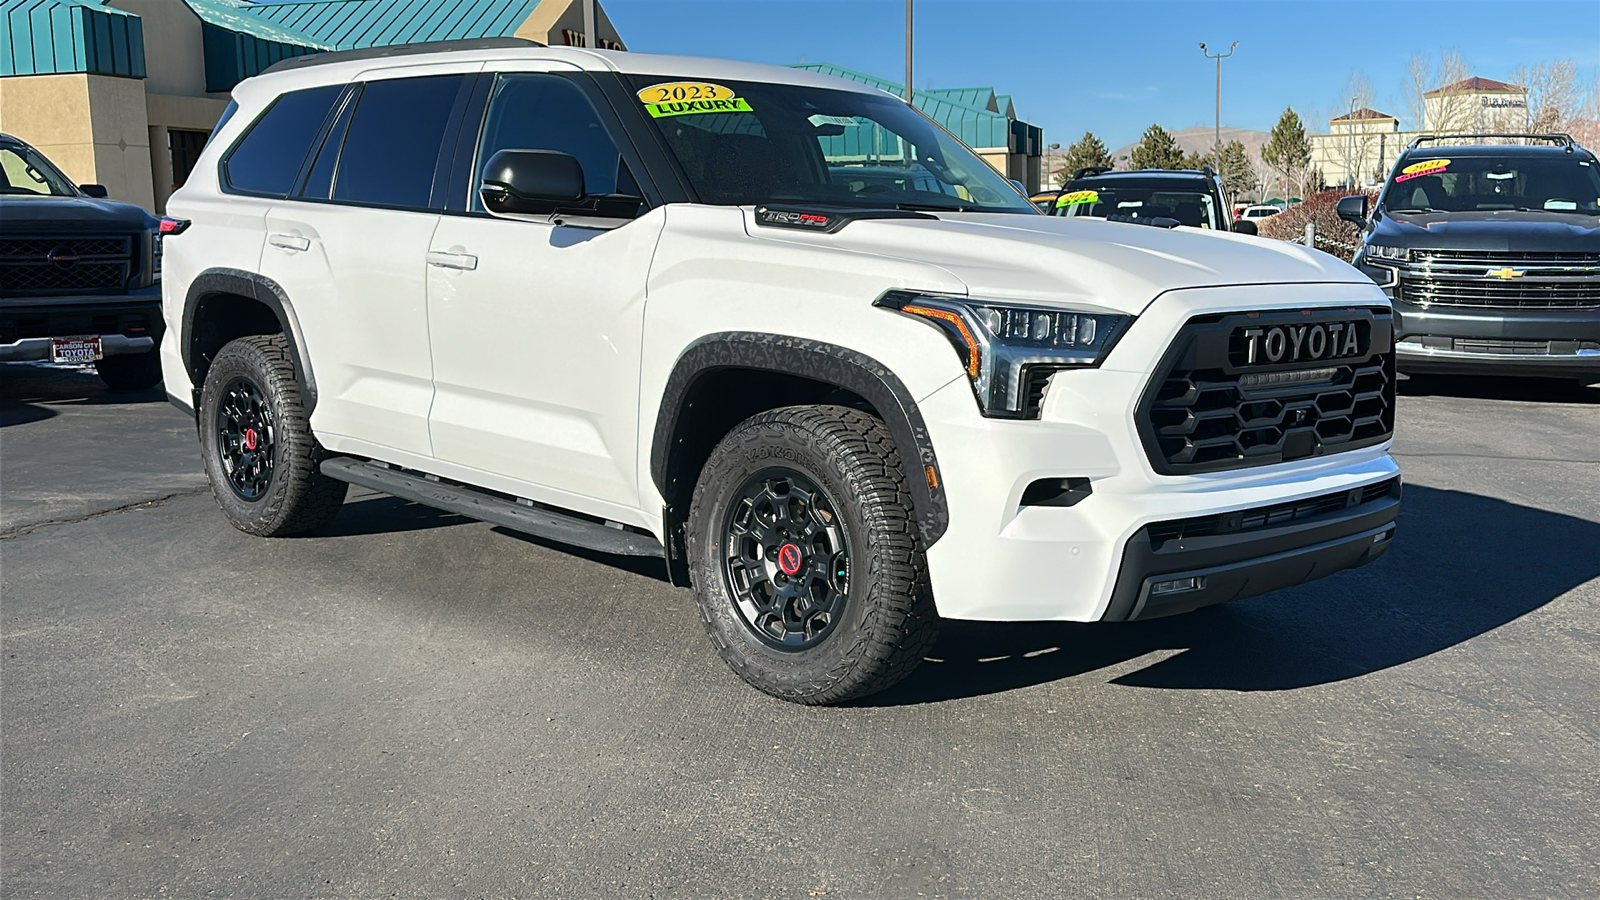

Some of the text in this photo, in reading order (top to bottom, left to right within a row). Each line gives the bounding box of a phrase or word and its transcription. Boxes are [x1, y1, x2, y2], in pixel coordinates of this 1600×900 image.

[656, 86, 717, 102] 2023
[656, 100, 741, 114] LUXURY
[1245, 323, 1358, 363] TOYOTA
[59, 349, 95, 357] TOYOTA
